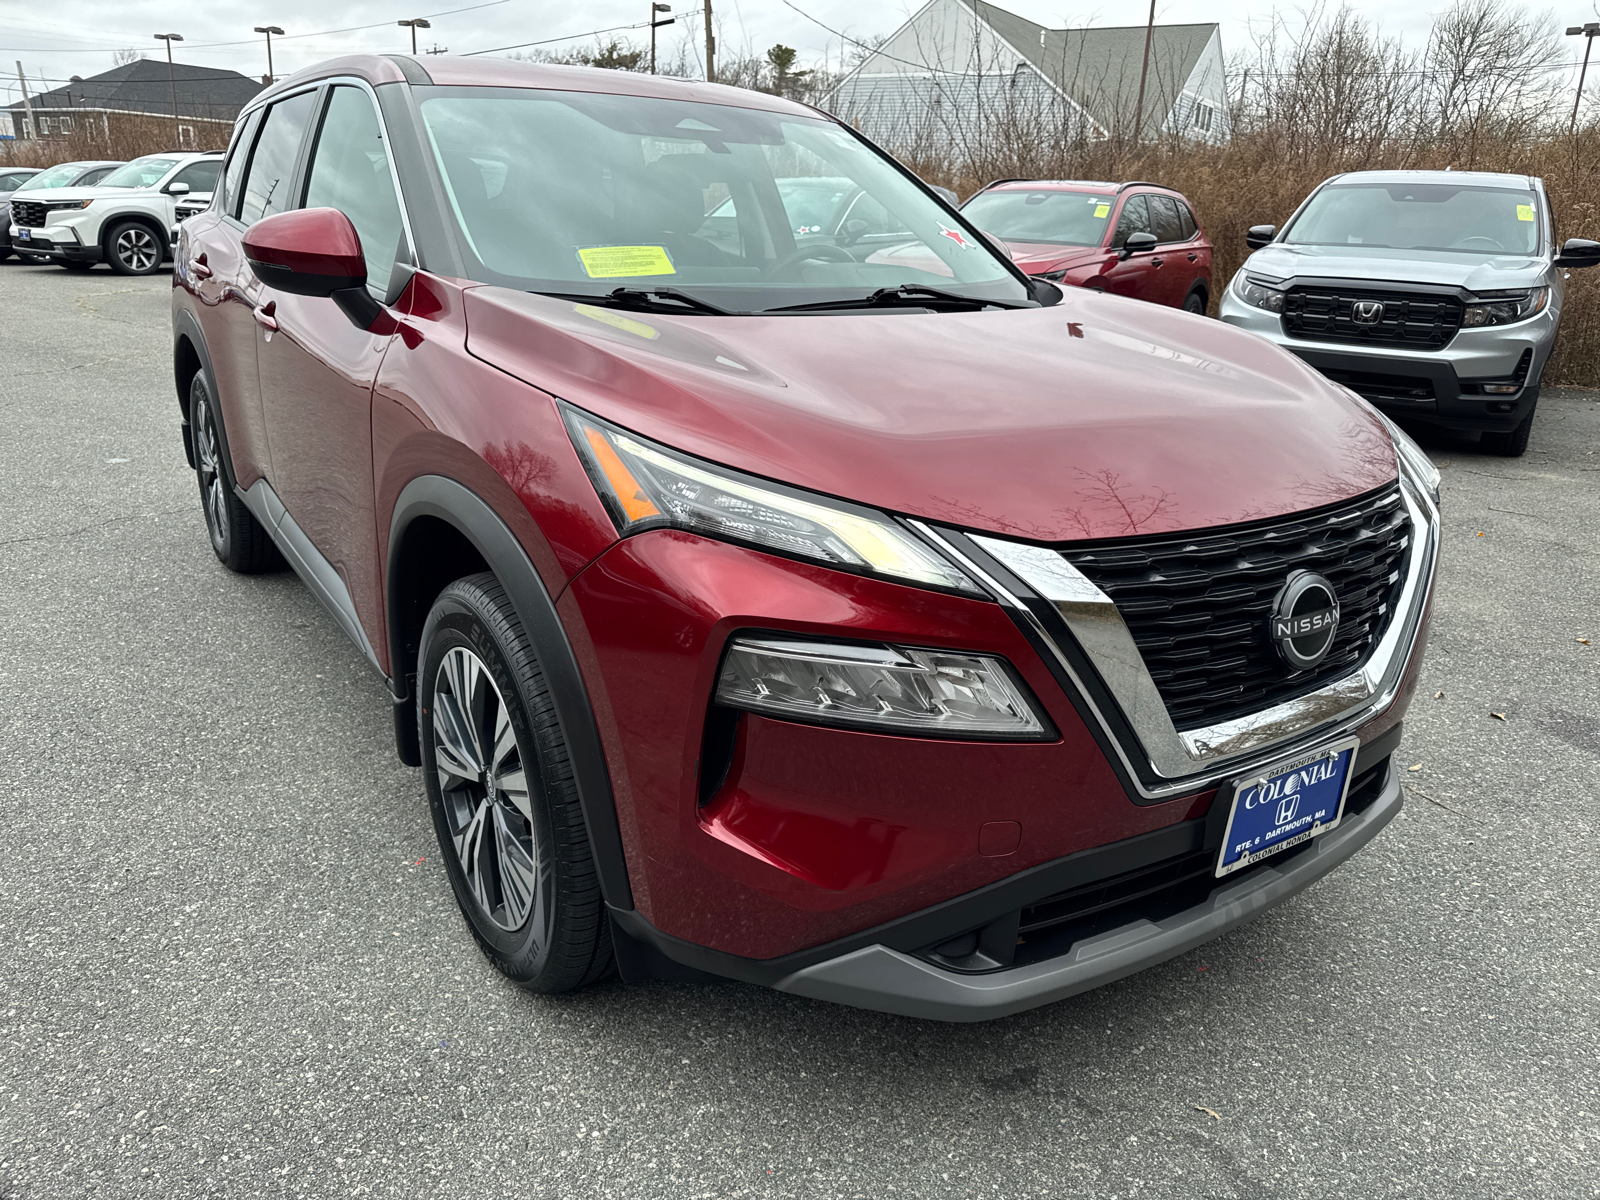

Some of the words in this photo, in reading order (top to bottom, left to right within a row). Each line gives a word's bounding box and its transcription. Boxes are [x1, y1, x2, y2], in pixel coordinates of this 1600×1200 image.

[1277, 609, 1339, 636] NISSAN
[470, 623, 525, 730] SUMMIT
[1245, 761, 1338, 810] COLONIAL
[1235, 842, 1253, 854] RTE.
[1254, 836, 1261, 845] 6
[1265, 814, 1313, 841] DARTMOUTH,
[1314, 809, 1326, 820] MA
[1247, 841, 1285, 864] COLONIAL
[1285, 831, 1312, 848] HONDA
[494, 938, 540, 975] ULTRAMAX
